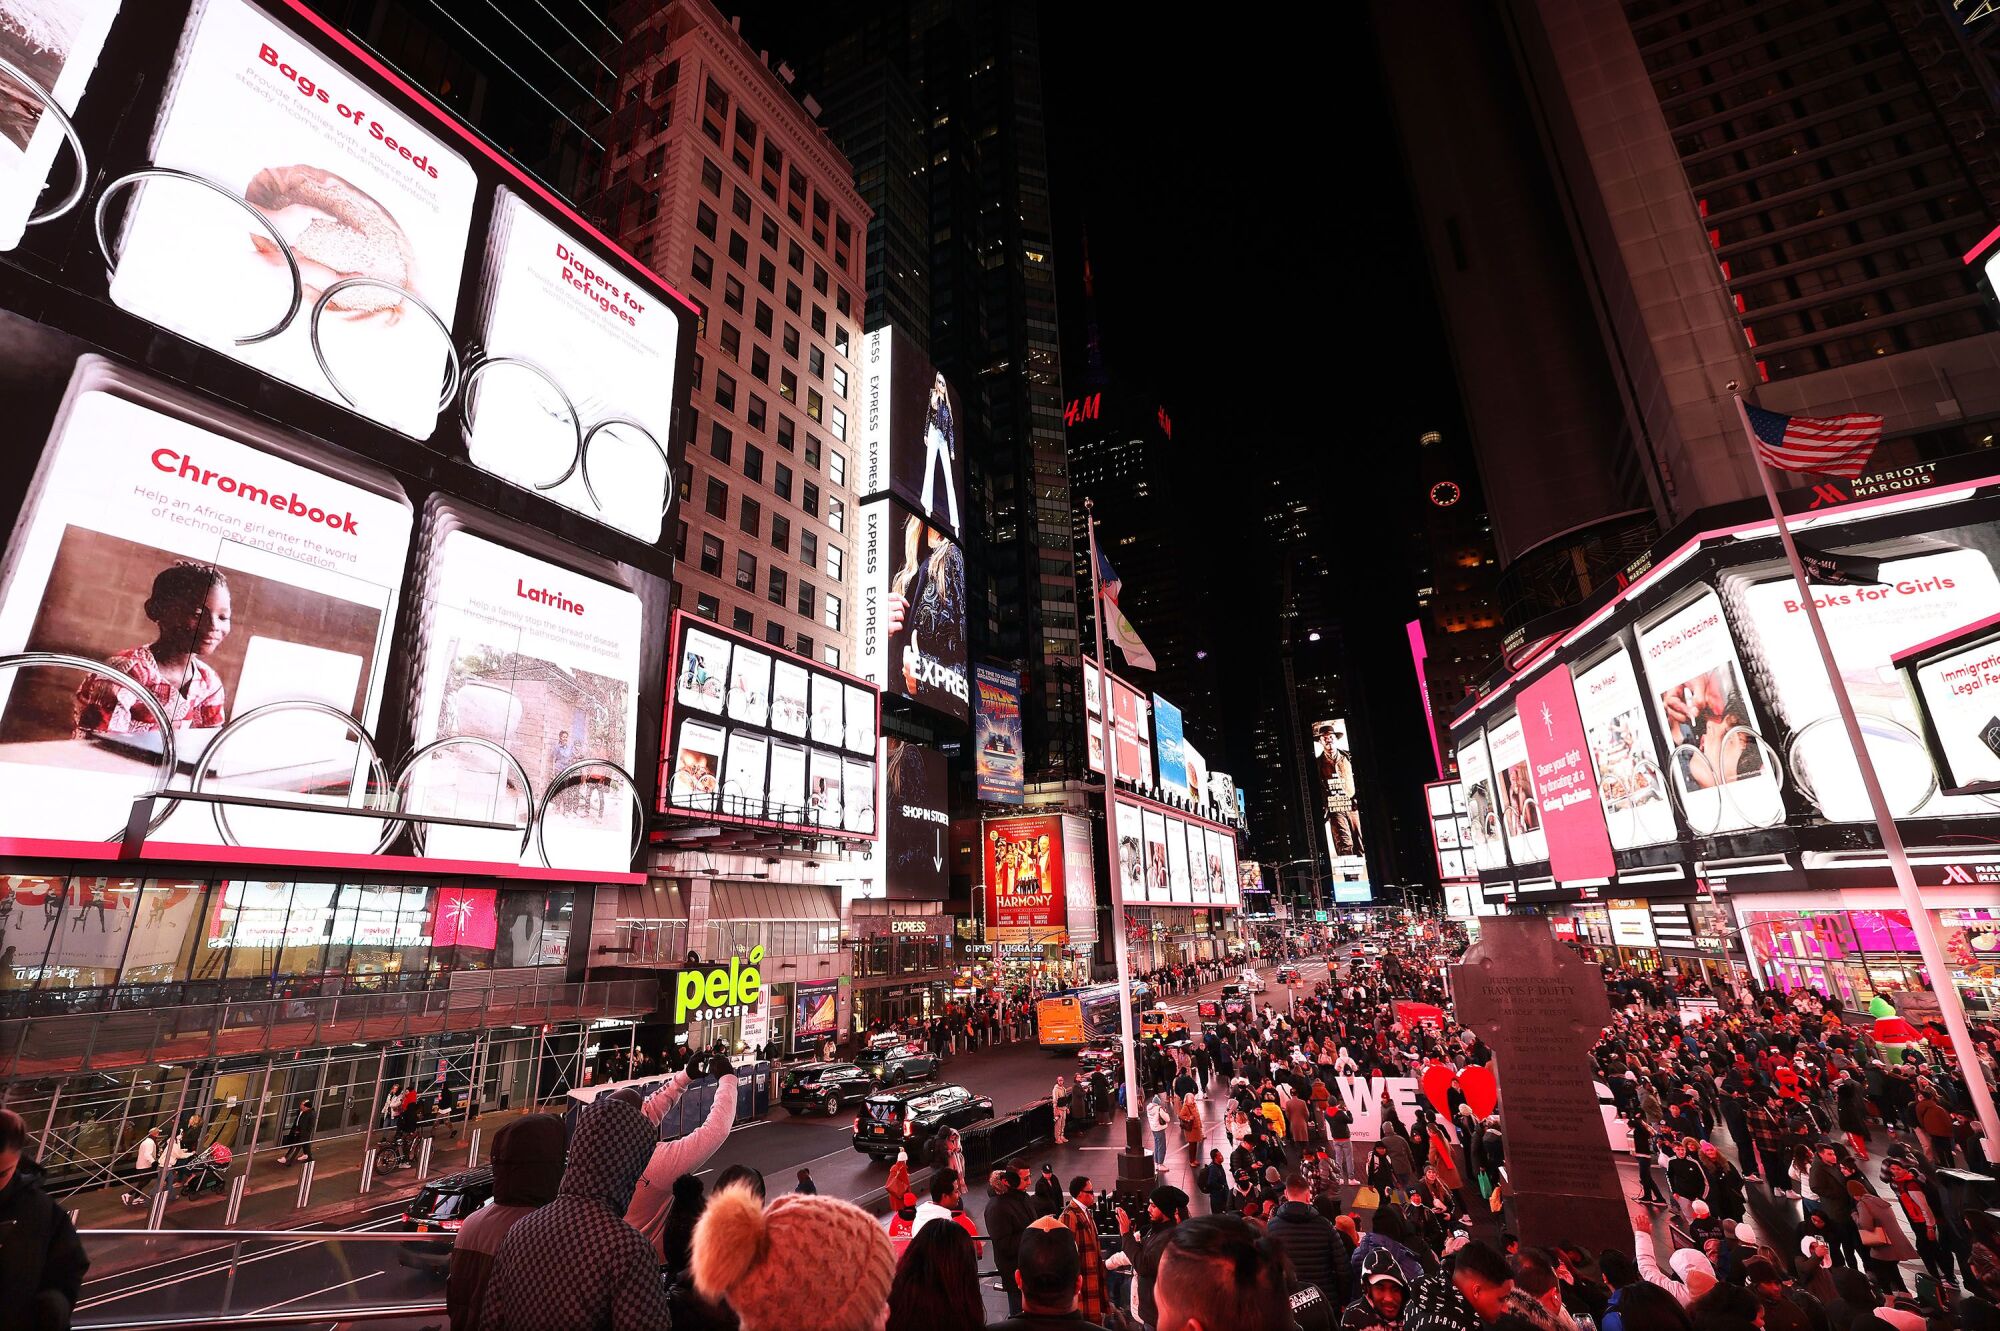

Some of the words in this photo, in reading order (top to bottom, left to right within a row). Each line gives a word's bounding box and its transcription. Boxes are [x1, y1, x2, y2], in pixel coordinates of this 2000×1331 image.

[259, 42, 330, 104] Bags
[336, 103, 365, 126] of
[368, 121, 439, 179] Seeds
[556, 243, 620, 298] Diapers
[623, 291, 645, 314] for
[561, 266, 636, 327] Refugees
[870, 375, 879, 432] EXPRESS
[1063, 393, 1101, 427] H&M
[868, 441, 878, 495] EXPRESS
[1850, 462, 1937, 487] MARRIOTT
[1854, 475, 1932, 497] MARQUIS
[150, 448, 359, 537] Chromebook
[133, 485, 169, 505] Help
[172, 498, 190, 512] an
[195, 504, 242, 527] African
[243, 520, 266, 534] girl
[267, 527, 301, 545] enter
[303, 537, 322, 553] the
[325, 545, 358, 564] world
[151, 507, 169, 518] of
[170, 513, 246, 544] technology
[249, 536, 274, 551] and
[867, 513, 877, 574] EXPRESS
[516, 578, 585, 616] Latrine
[1855, 587, 1890, 604] for
[1895, 576, 1955, 597] Girls
[469, 597, 490, 611] Help
[498, 607, 524, 623] family
[525, 615, 543, 628] stop
[543, 620, 557, 631] the
[558, 624, 583, 640] spread
[584, 632, 593, 641] of
[865, 586, 876, 656] EXPRESS
[1662, 634, 1681, 653] Polio
[1682, 613, 1719, 641] Vaccines
[1950, 675, 1983, 696] Legal
[1984, 673, 2000, 686] Fe
[1536, 762, 1554, 778] Share
[1552, 756, 1567, 774] your
[1565, 749, 1582, 767] light
[1539, 782, 1548, 797] by
[1547, 774, 1574, 793] donating
[1571, 770, 1580, 783] at
[1579, 770, 1585, 780] a
[902, 804, 923, 820] SHOP
[923, 808, 931, 820] IN
[995, 892, 1053, 908] HARMONY
[890, 920, 927, 933] EXPRESS
[1696, 937, 1734, 949] SEPHOA
[965, 944, 993, 953] GIFTS
[999, 944, 1044, 953] LUGGAGE
[675, 944, 765, 1025] pelé
[1482, 986, 1526, 995] FRANCIS
[1538, 986, 1575, 995] DUFFY
[695, 1004, 750, 1022] SOCCER
[1332, 1077, 1436, 1141] WE
